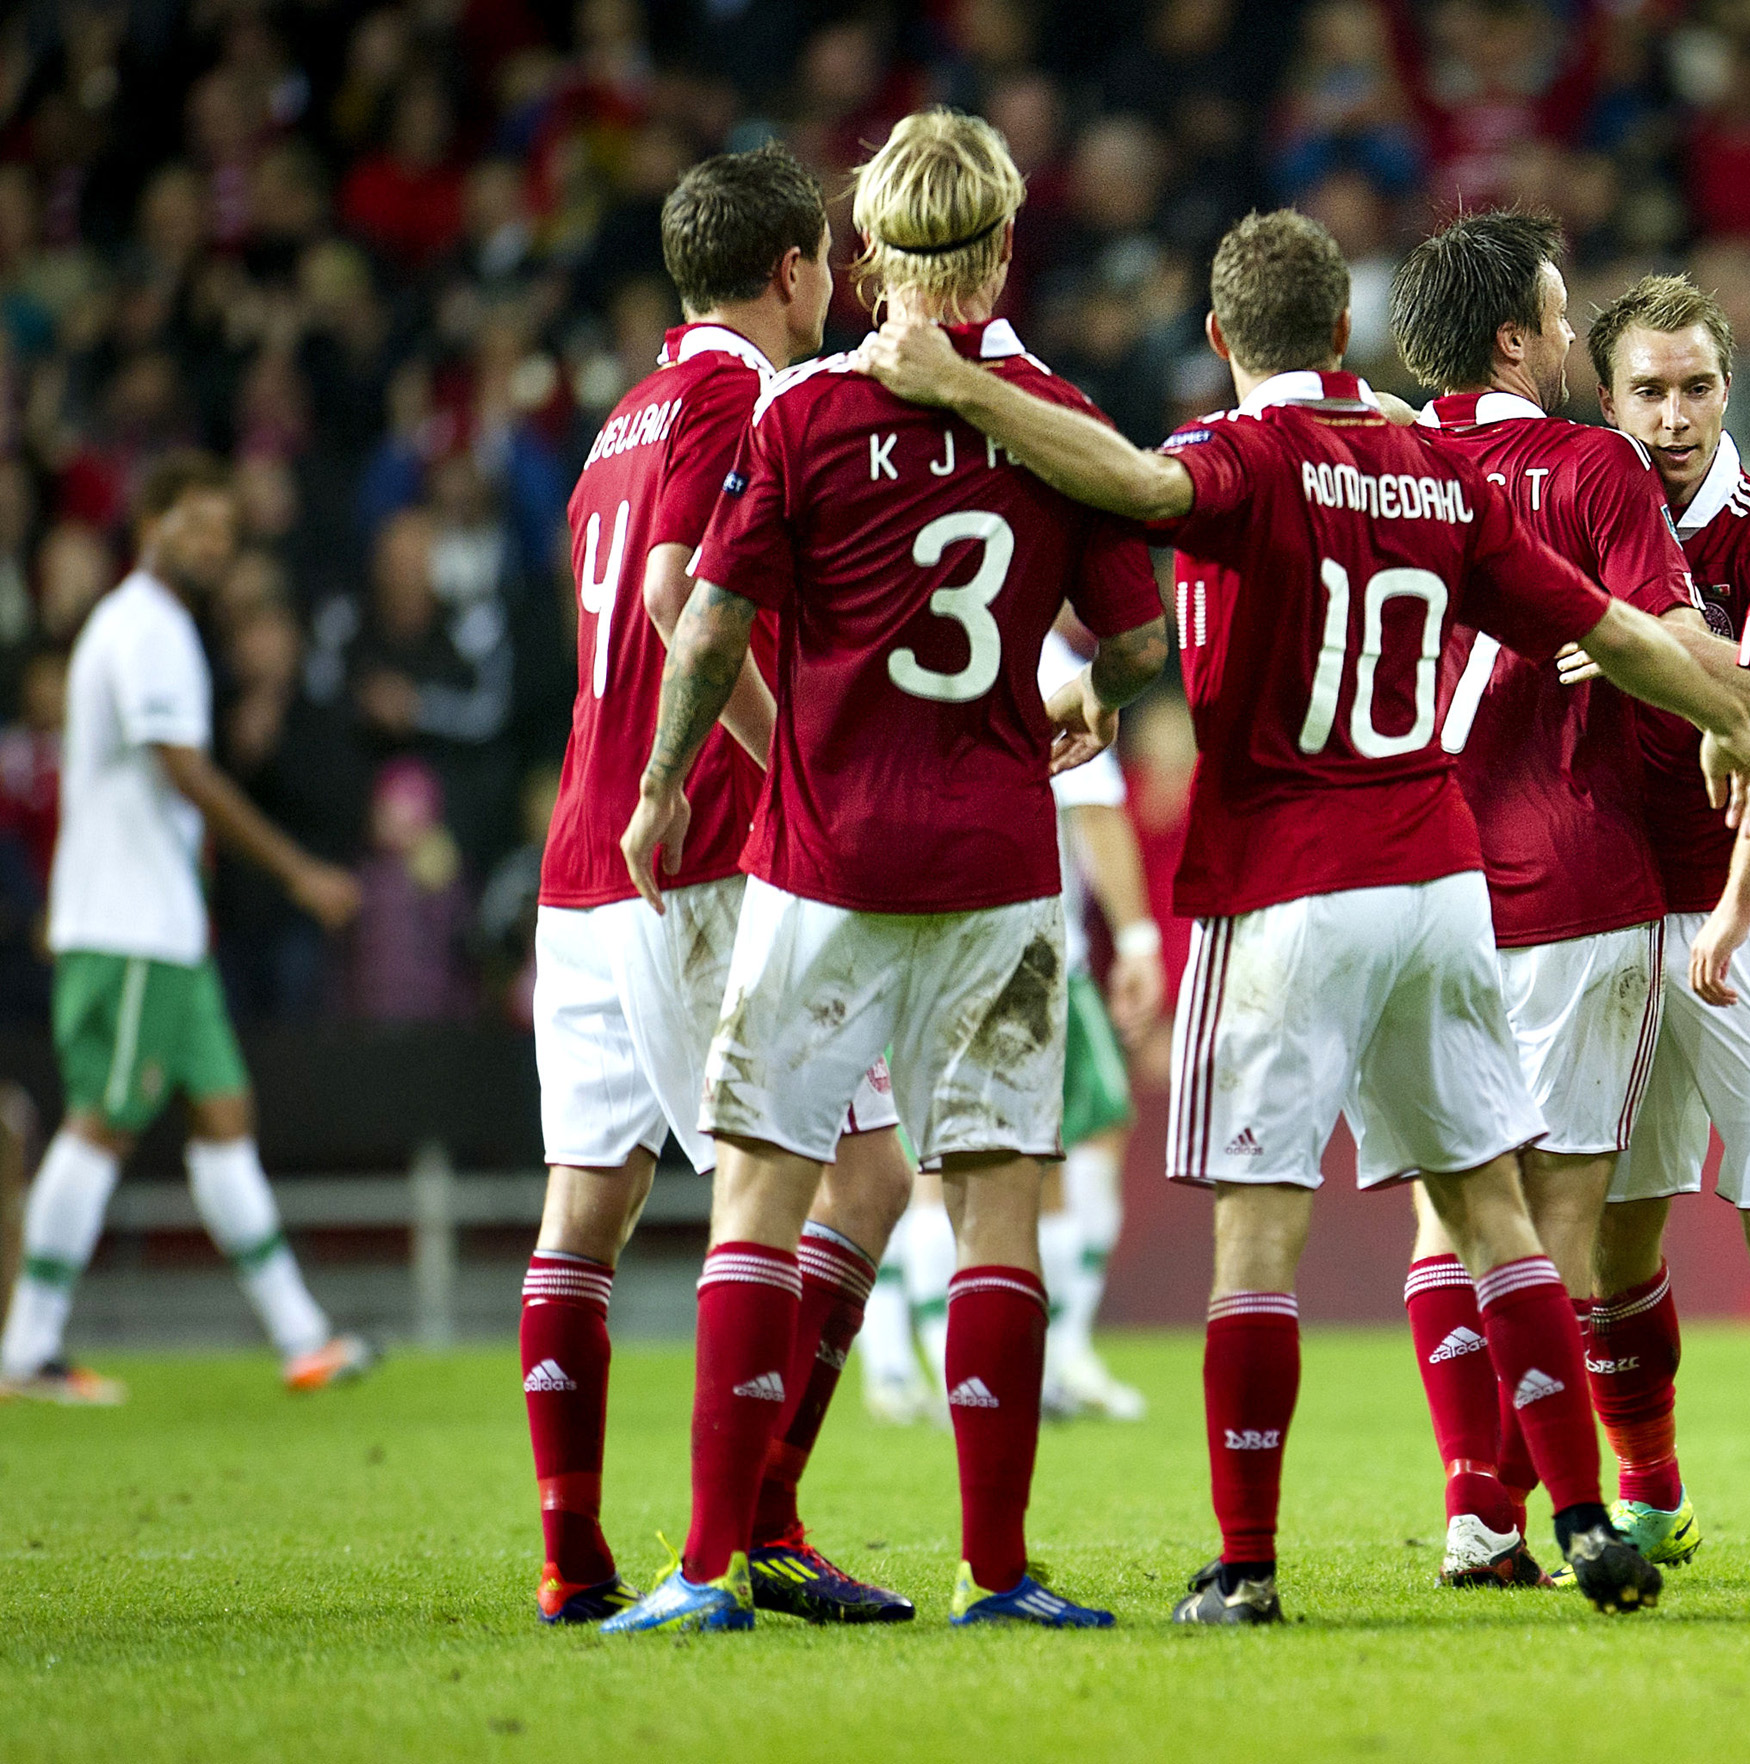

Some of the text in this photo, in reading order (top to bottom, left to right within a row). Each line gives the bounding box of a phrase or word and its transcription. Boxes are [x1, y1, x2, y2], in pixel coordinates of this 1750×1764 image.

[581, 500, 630, 699] 4
[888, 510, 1014, 703] 3
[1300, 556, 1449, 759] 10
[1225, 1145, 1264, 1156] adidas
[1429, 1336, 1489, 1364] adidas
[524, 1376, 578, 1393] adidas
[1514, 1379, 1565, 1410] adidas
[950, 1394, 999, 1409] adidas
[1224, 1428, 1280, 1450] DBU
